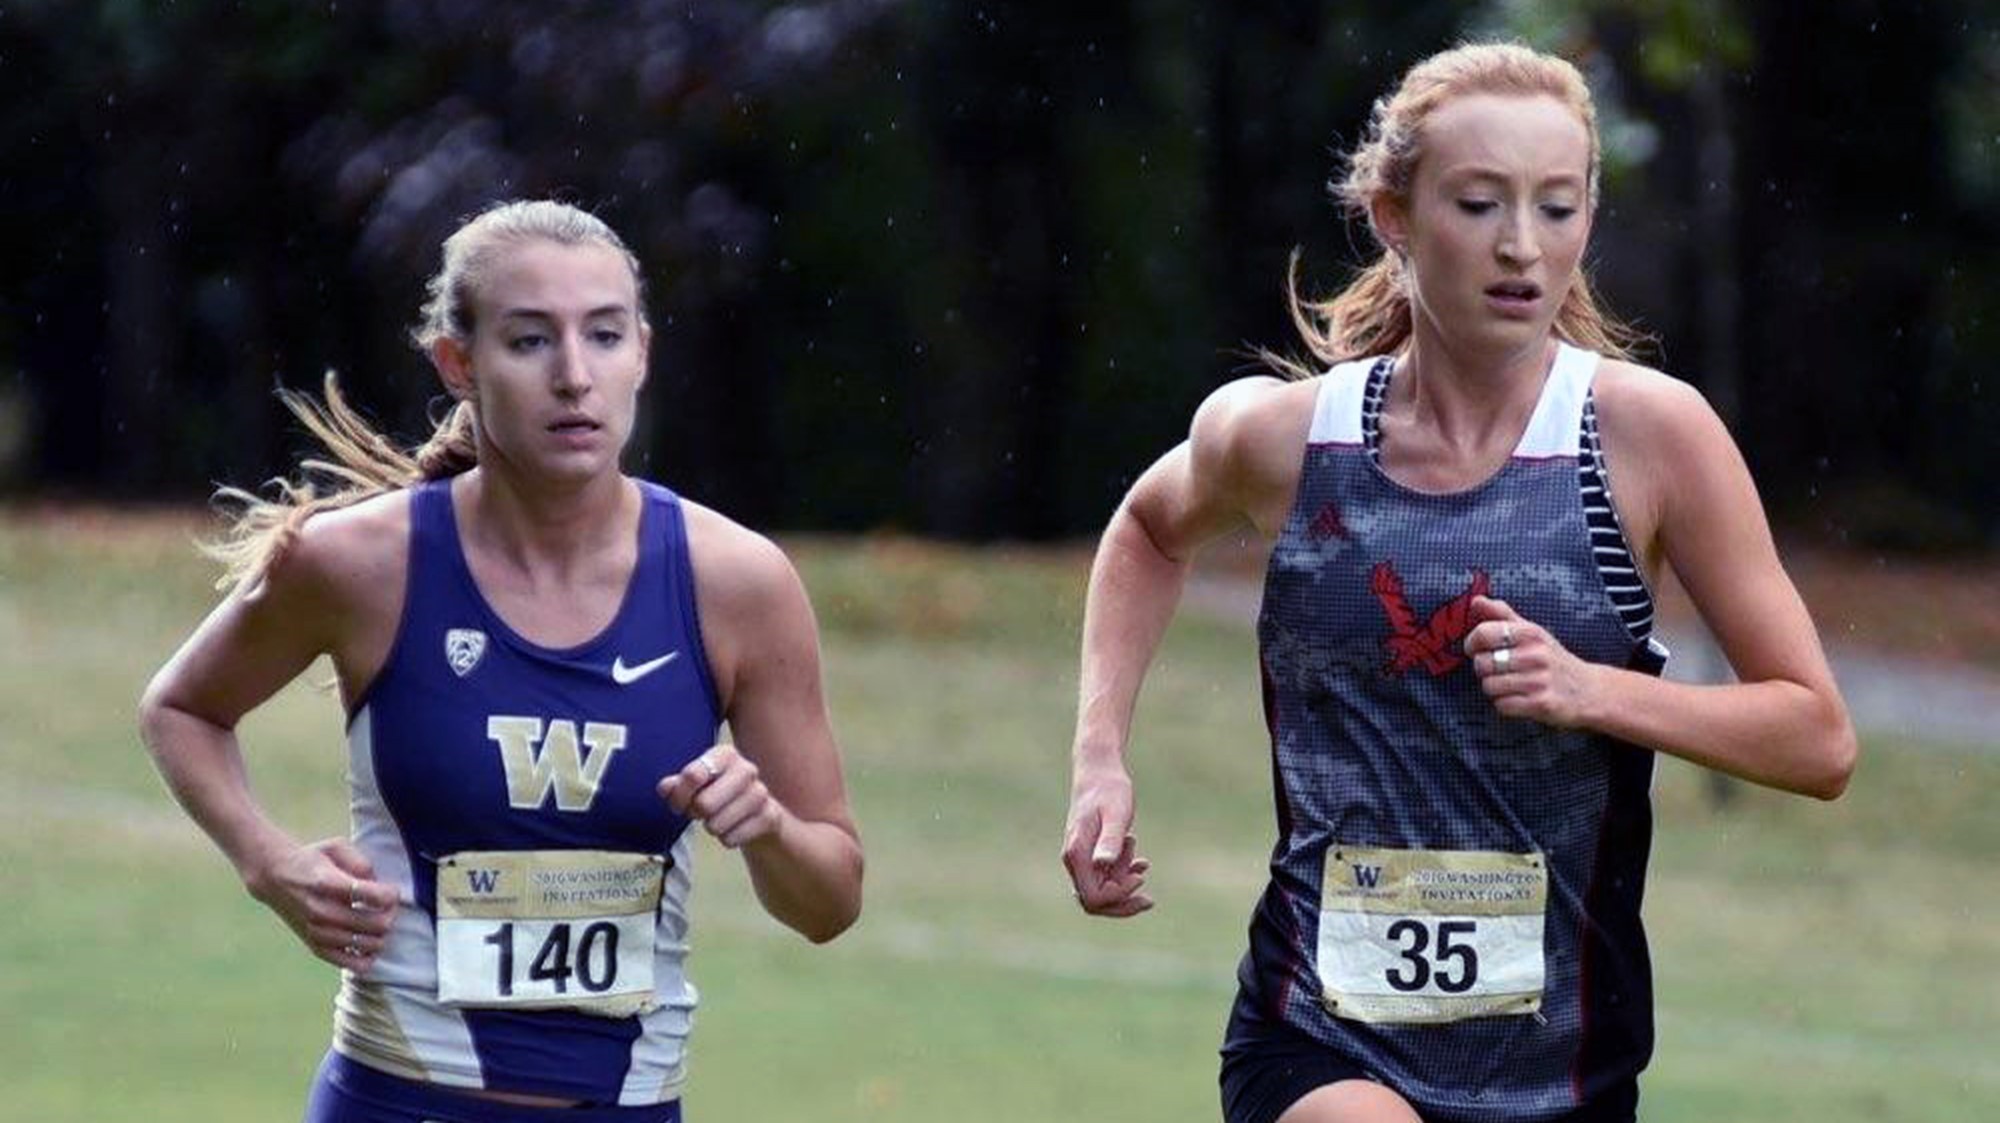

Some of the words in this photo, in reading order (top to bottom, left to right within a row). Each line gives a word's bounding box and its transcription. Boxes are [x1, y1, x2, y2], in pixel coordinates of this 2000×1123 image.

[487, 715, 627, 811] W
[466, 869, 500, 893] W
[1352, 864, 1382, 888] W
[484, 920, 620, 997] 140
[1385, 919, 1479, 993] 35
